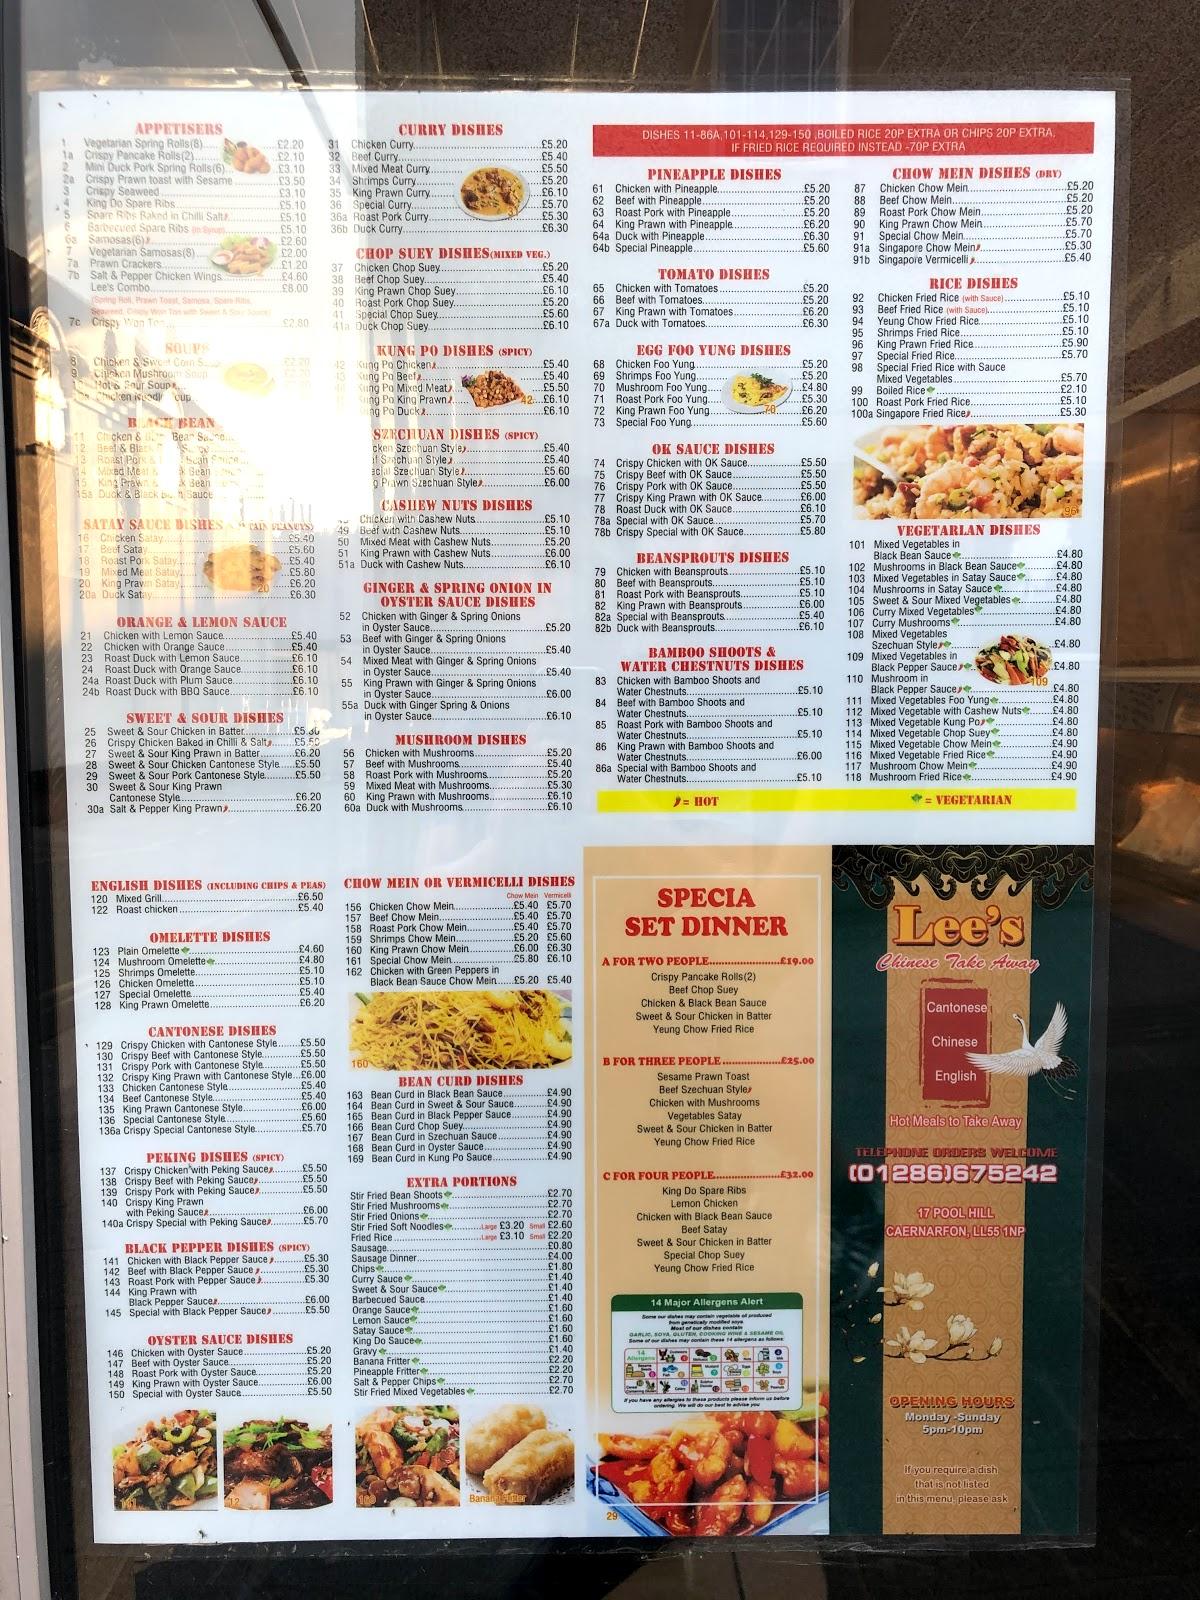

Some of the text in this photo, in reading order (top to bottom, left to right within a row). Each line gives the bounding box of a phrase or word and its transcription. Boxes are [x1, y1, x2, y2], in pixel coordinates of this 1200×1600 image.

[135, 122, 222, 136] APPETISERS
[398, 123, 503, 136] CURRY DISHES
[328, 139, 568, 152] 31 Chicken Curry £5.20
[731, 142, 740, 153] IF
[743, 142, 773, 153] FRIED
[775, 142, 800, 153] RICE
[802, 141, 856, 153] REQUIRED
[858, 141, 903, 153] INSTEAD
[932, 140, 966, 152] EXTRA
[647, 168, 781, 181] PINEAPPLE DISHES
[592, 183, 831, 196] 61 Chicken with Pineapple £5.20
[854, 182, 968, 194] 87 Chicken Chow Mein
[90, 259, 120, 269] Prawn
[121, 259, 162, 269] Crackers
[658, 268, 769, 281] TOMATO DISHES
[929, 277, 1017, 290] RICE DISHES
[651, 443, 774, 455] OK SAUCE DISHES
[989, 524, 1040, 536] DISHES
[636, 551, 789, 564] BEANSPROUTS DISHES
[116, 616, 286, 628] ORANGE & LEMON SAUCE
[648, 646, 775, 659] BAMBOO SHOOTS &
[620, 659, 803, 672] WATER CHESTNUTS DISHES
[82, 686, 319, 697] 24b Roast Duck with BBQ Sauce £6.10
[126, 712, 283, 724] SWEET & SOUR DISHES
[395, 734, 526, 746] MUSHROOM DISHES
[845, 771, 1077, 782] 118 Mushroom Fried Rice £4.90
[694, 796, 720, 807] HOT
[935, 794, 1012, 806] VEGETARIAN
[343, 875, 575, 889] CHOW MEIN OR VERMICELLI DISHES
[91, 891, 324, 904] 120 Mixed Grill £6.50
[657, 887, 756, 909] SPECIA
[624, 915, 788, 937] SET DINNER
[892, 904, 1025, 947] Lee's
[149, 931, 270, 944] OMELETTE DISHES
[601, 956, 814, 967] A FOR TWO PEOPLE £19.00
[876, 953, 1041, 975] Chinese Take Away
[651, 971, 757, 984] Crispy Pancake Rolls(2)
[94, 999, 210, 1011] 128 King Prawn Omelette
[926, 1001, 988, 1013] Cantonese
[148, 1024, 276, 1038] CANTONESE DISHES
[931, 1035, 978, 1048] Chinese
[398, 1074, 523, 1087] BEAN CURD DISHES
[935, 1069, 977, 1084] English
[890, 1115, 1023, 1130] Hot Meals to Take Away
[146, 1151, 285, 1163] PEKING DISHES (SPICY)
[855, 1147, 1059, 1158] TELEPHONE ORDERS WELCOME
[848, 1163, 1058, 1184] (01286)675242
[407, 1175, 517, 1188] EXTRA PORTIONS
[917, 1207, 995, 1219] 17 POOL HILL
[885, 1225, 1026, 1239] CAERNARFON, LL55 1NP
[351, 1253, 418, 1264] Sausage Dinner
[650, 1297, 764, 1308] 14 Major Allergens Alert
[147, 1333, 293, 1346] OYSTER SAUCE DISHES
[353, 1385, 574, 1398] Stir Fried Mixed Vegetables £2.70
[889, 1396, 1015, 1408] OPENING HOURS
[905, 1412, 951, 1424] Monday
[922, 1424, 984, 1435] 5pm-10pm
[915, 1479, 989, 1489] that is not listed
